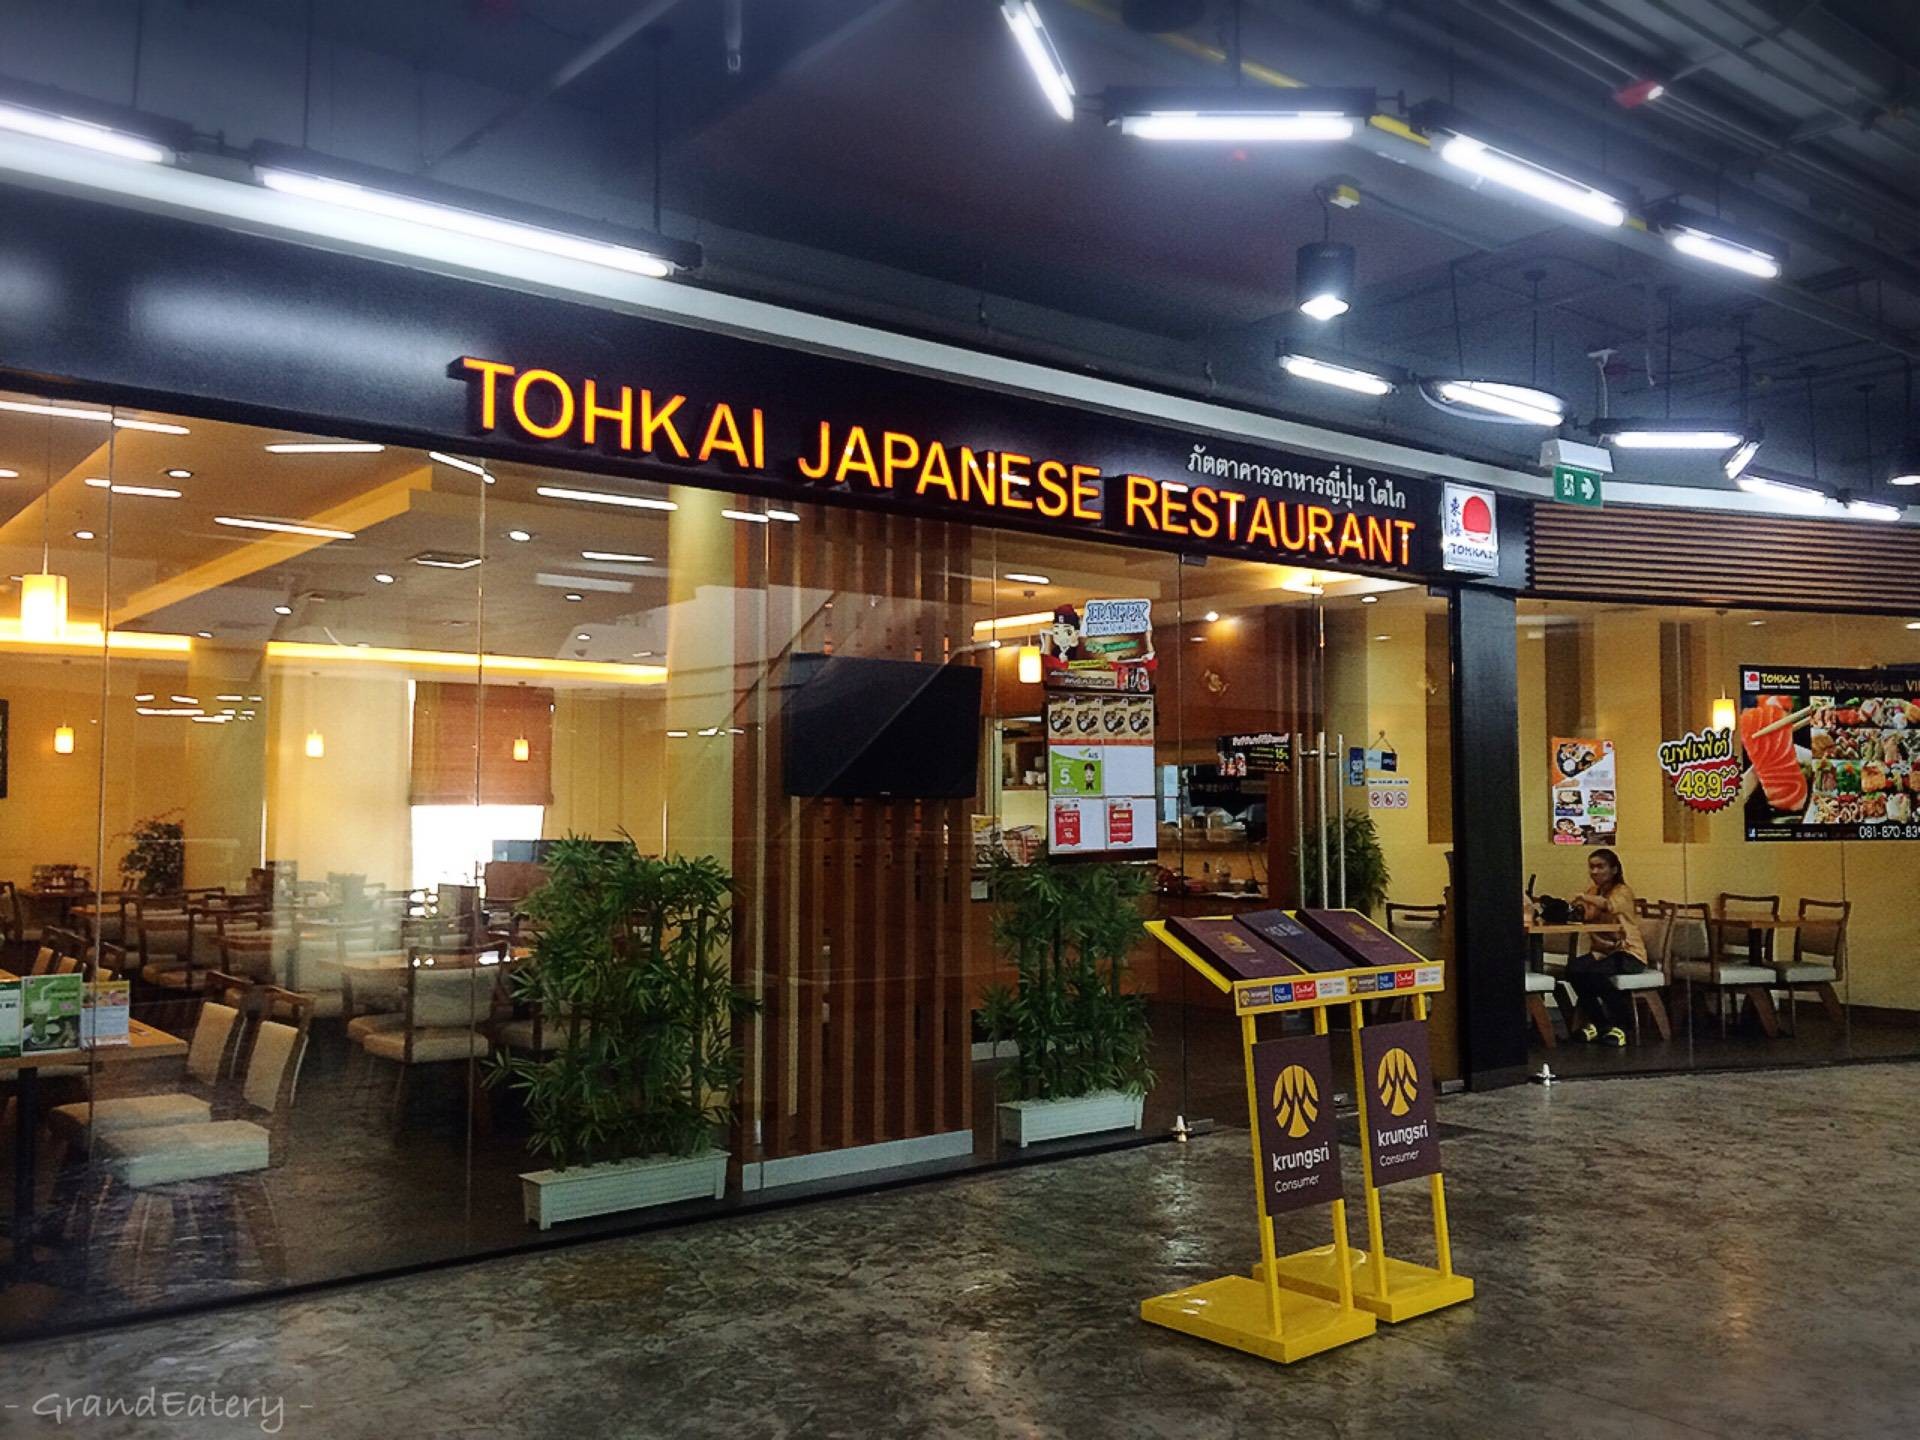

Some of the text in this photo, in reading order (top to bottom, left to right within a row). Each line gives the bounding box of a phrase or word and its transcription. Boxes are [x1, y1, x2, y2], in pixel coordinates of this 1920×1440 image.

[462, 357, 1417, 566] TOHKAI JAPANESE RESTAURANT
[1377, 1119, 1429, 1147] krungsri
[1272, 1141, 1330, 1172] krungsri
[1379, 1149, 1420, 1167] Consumer
[1274, 1174, 1320, 1193] Consumer
